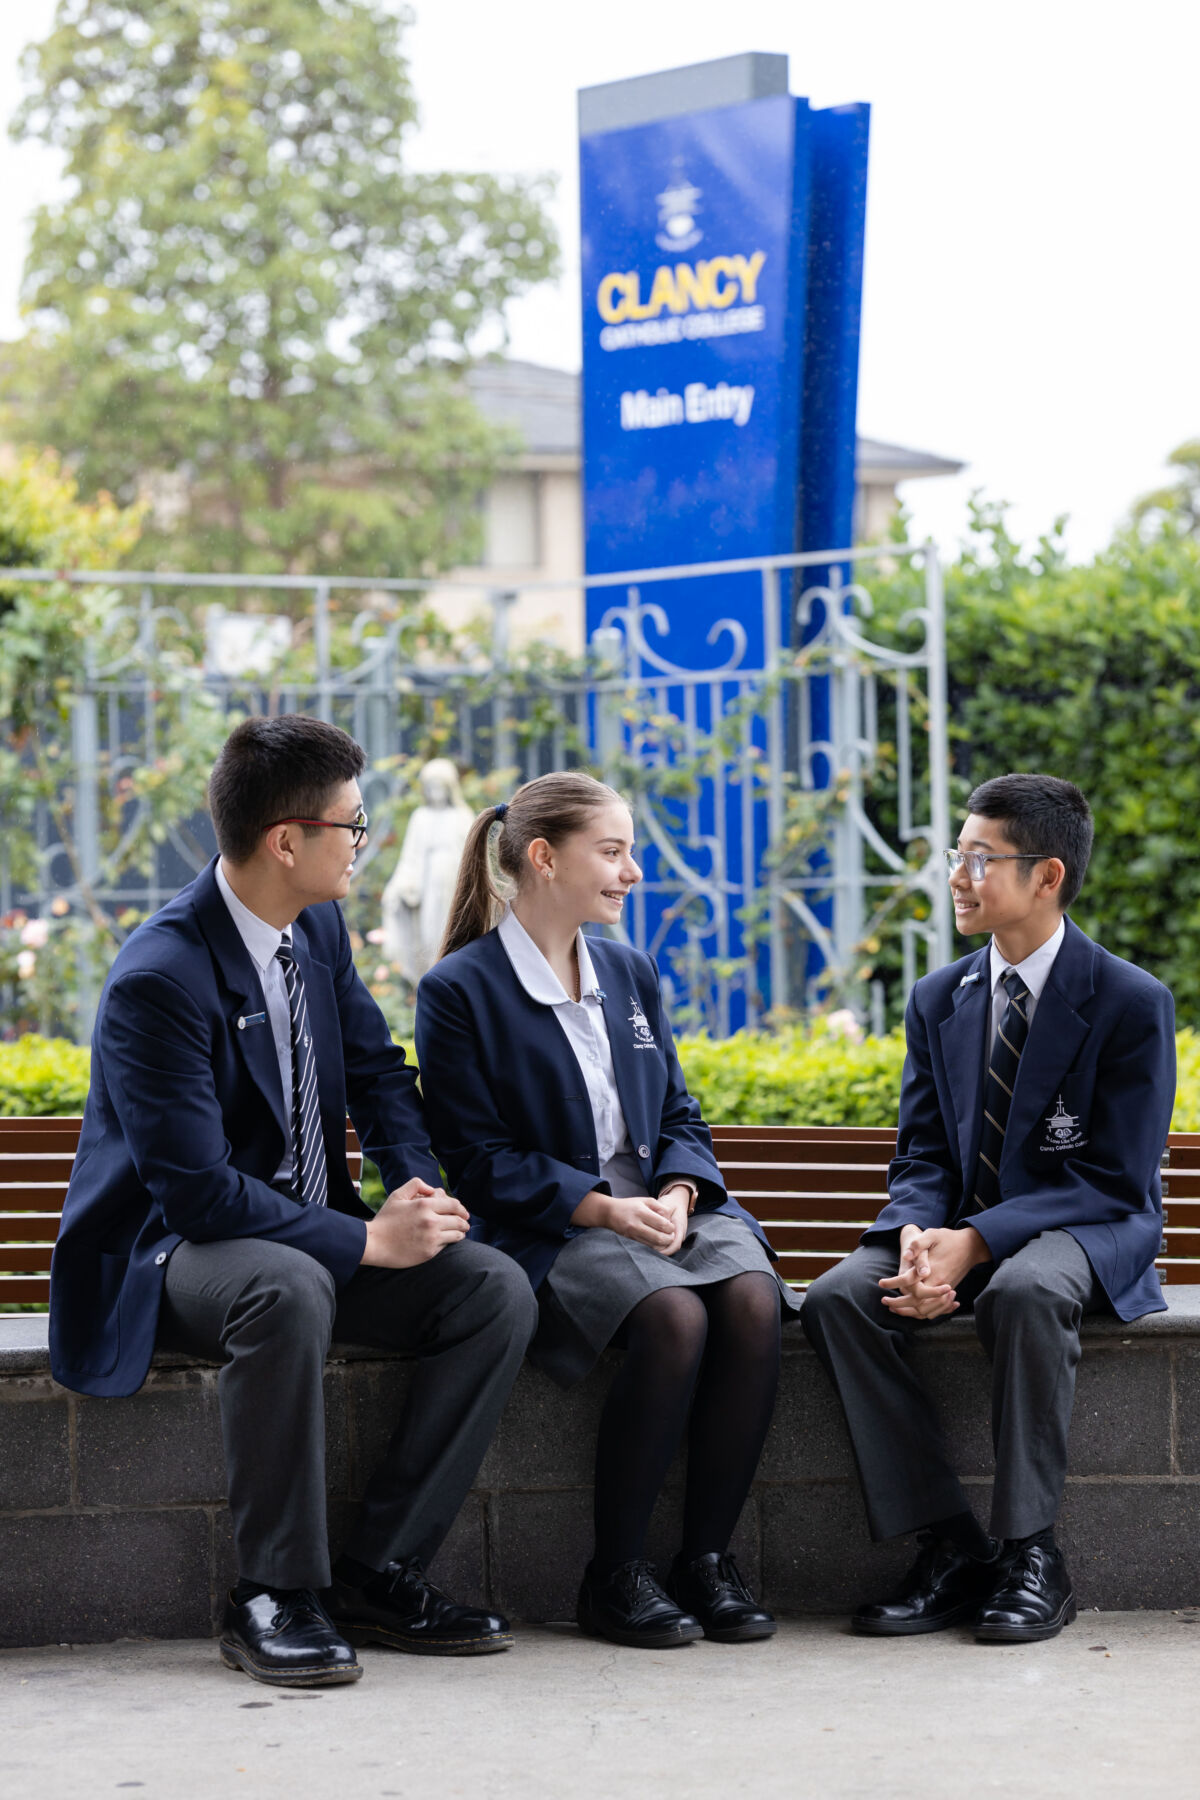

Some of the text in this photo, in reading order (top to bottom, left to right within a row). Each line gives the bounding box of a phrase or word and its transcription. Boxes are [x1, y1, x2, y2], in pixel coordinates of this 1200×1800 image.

[597, 251, 767, 324] CLANCY
[620, 381, 755, 431] Main Entry
